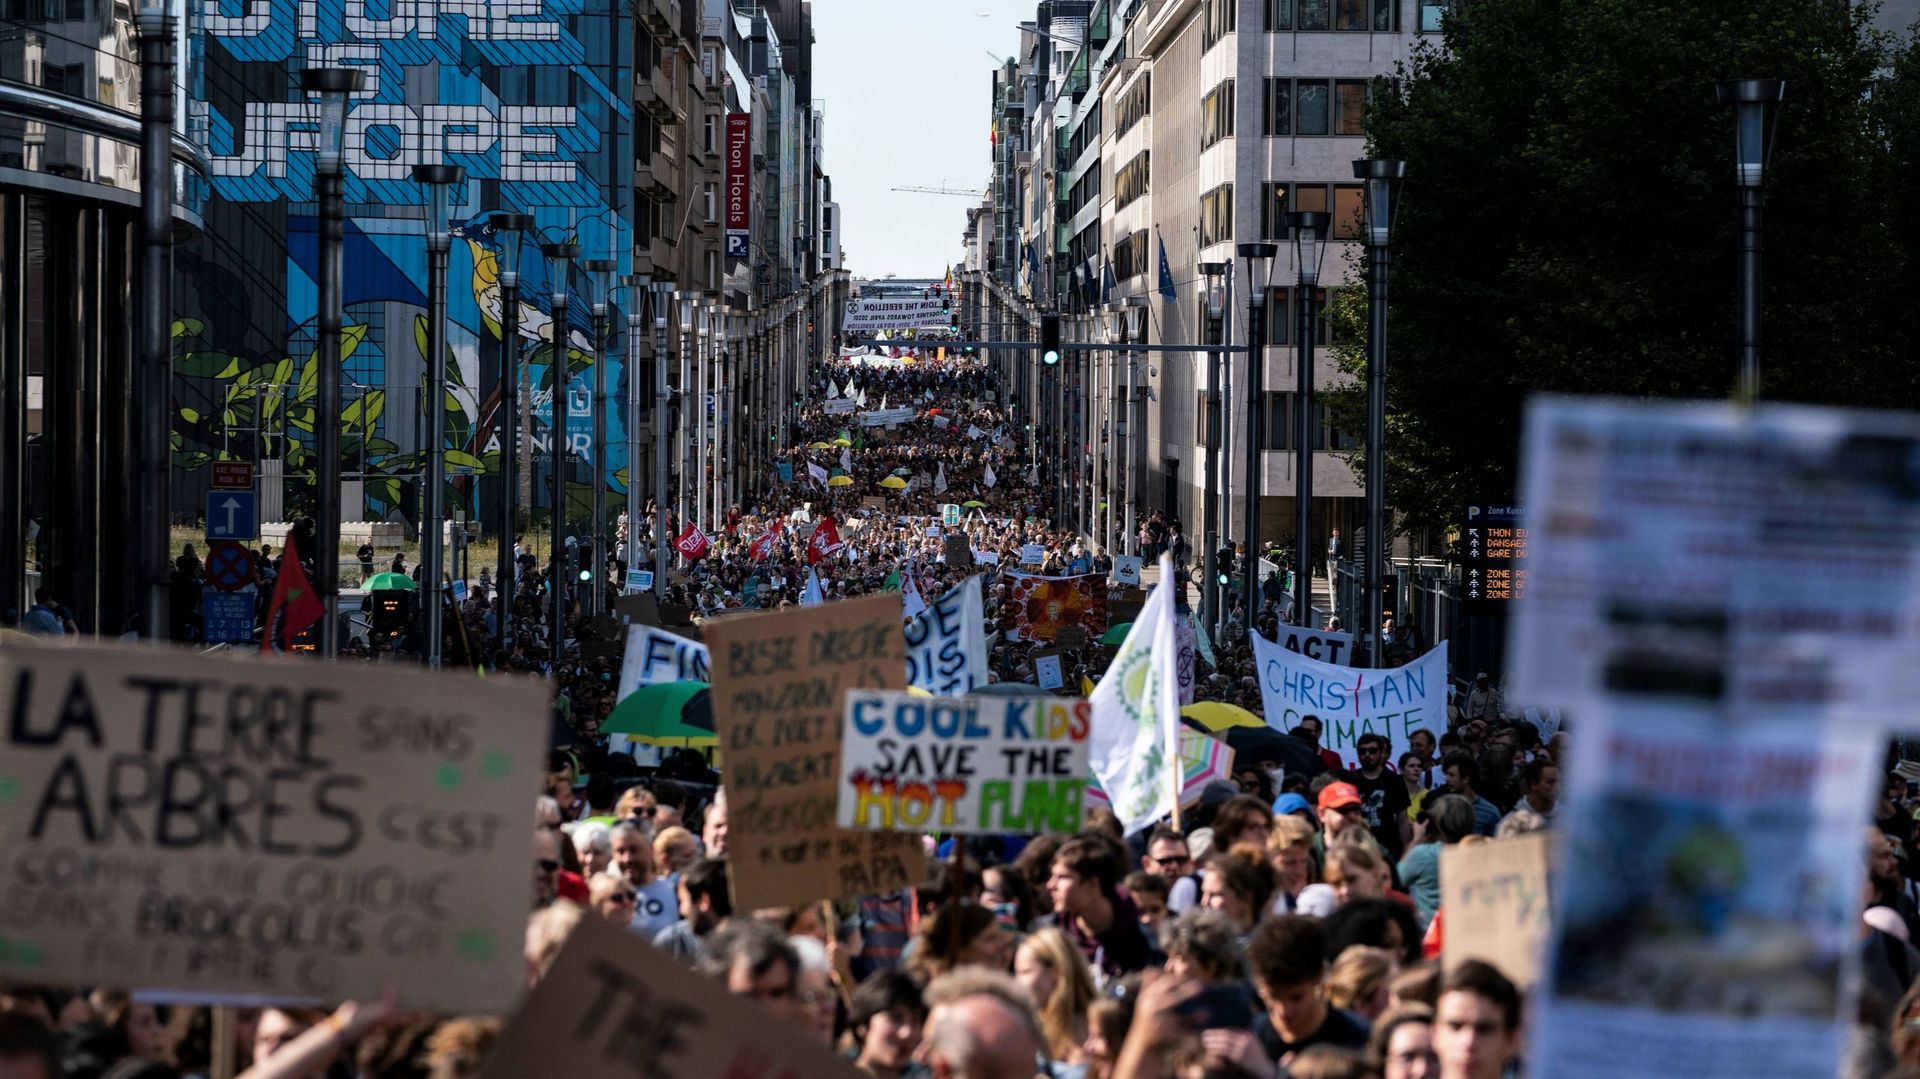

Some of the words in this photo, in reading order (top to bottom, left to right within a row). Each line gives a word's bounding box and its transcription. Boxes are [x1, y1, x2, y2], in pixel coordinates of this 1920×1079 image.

[731, 129, 745, 168] Thon
[731, 174, 745, 222] Hotels
[728, 235, 742, 253] P
[1468, 506, 1481, 520] P
[1487, 506, 1505, 515] Zone
[1487, 528, 1511, 537] THON
[1487, 549, 1511, 558] GARE
[1486, 580, 1511, 589] ZONE
[1487, 569, 1511, 578] ZONE
[1486, 590, 1510, 599] ZONE
[1284, 633, 1345, 665] ACT
[1266, 660, 1426, 718] CHRISTIAN
[8, 666, 104, 748] LA
[122, 675, 348, 772] TERRE
[853, 699, 991, 738] COOL
[1004, 698, 1092, 743] KIDS
[1283, 706, 1424, 752] CIMATE
[872, 737, 978, 776] SAVE
[1000, 745, 1074, 776] THE
[28, 752, 368, 858] ARBRES
[851, 768, 968, 829] HOT
